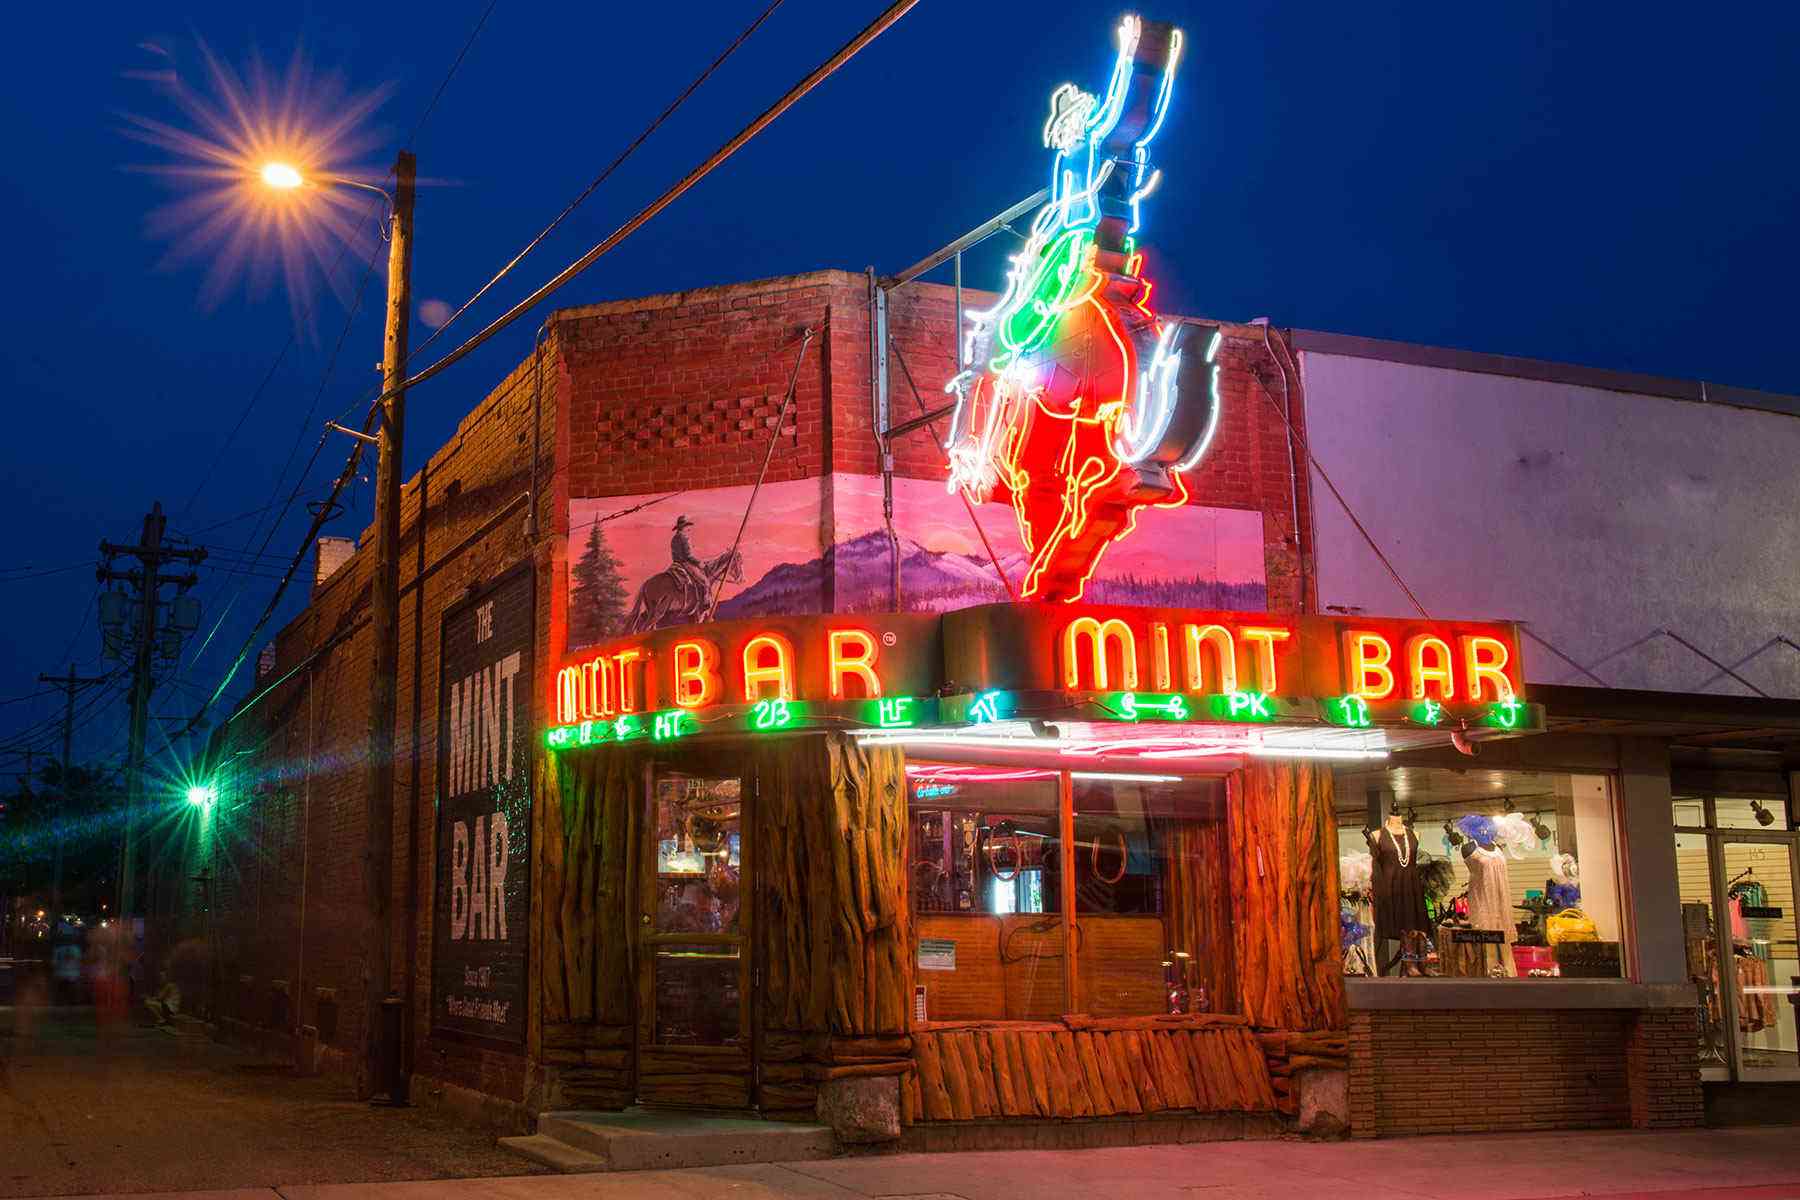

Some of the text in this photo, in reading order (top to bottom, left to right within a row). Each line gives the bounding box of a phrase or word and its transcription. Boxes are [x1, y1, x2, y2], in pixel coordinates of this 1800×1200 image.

[476, 600, 495, 644] THE
[1064, 616, 1516, 702] MINT BAR
[555, 649, 641, 723] MINT
[673, 627, 882, 708] BAR
[449, 651, 521, 798] MINT
[451, 811, 509, 940] BAR
